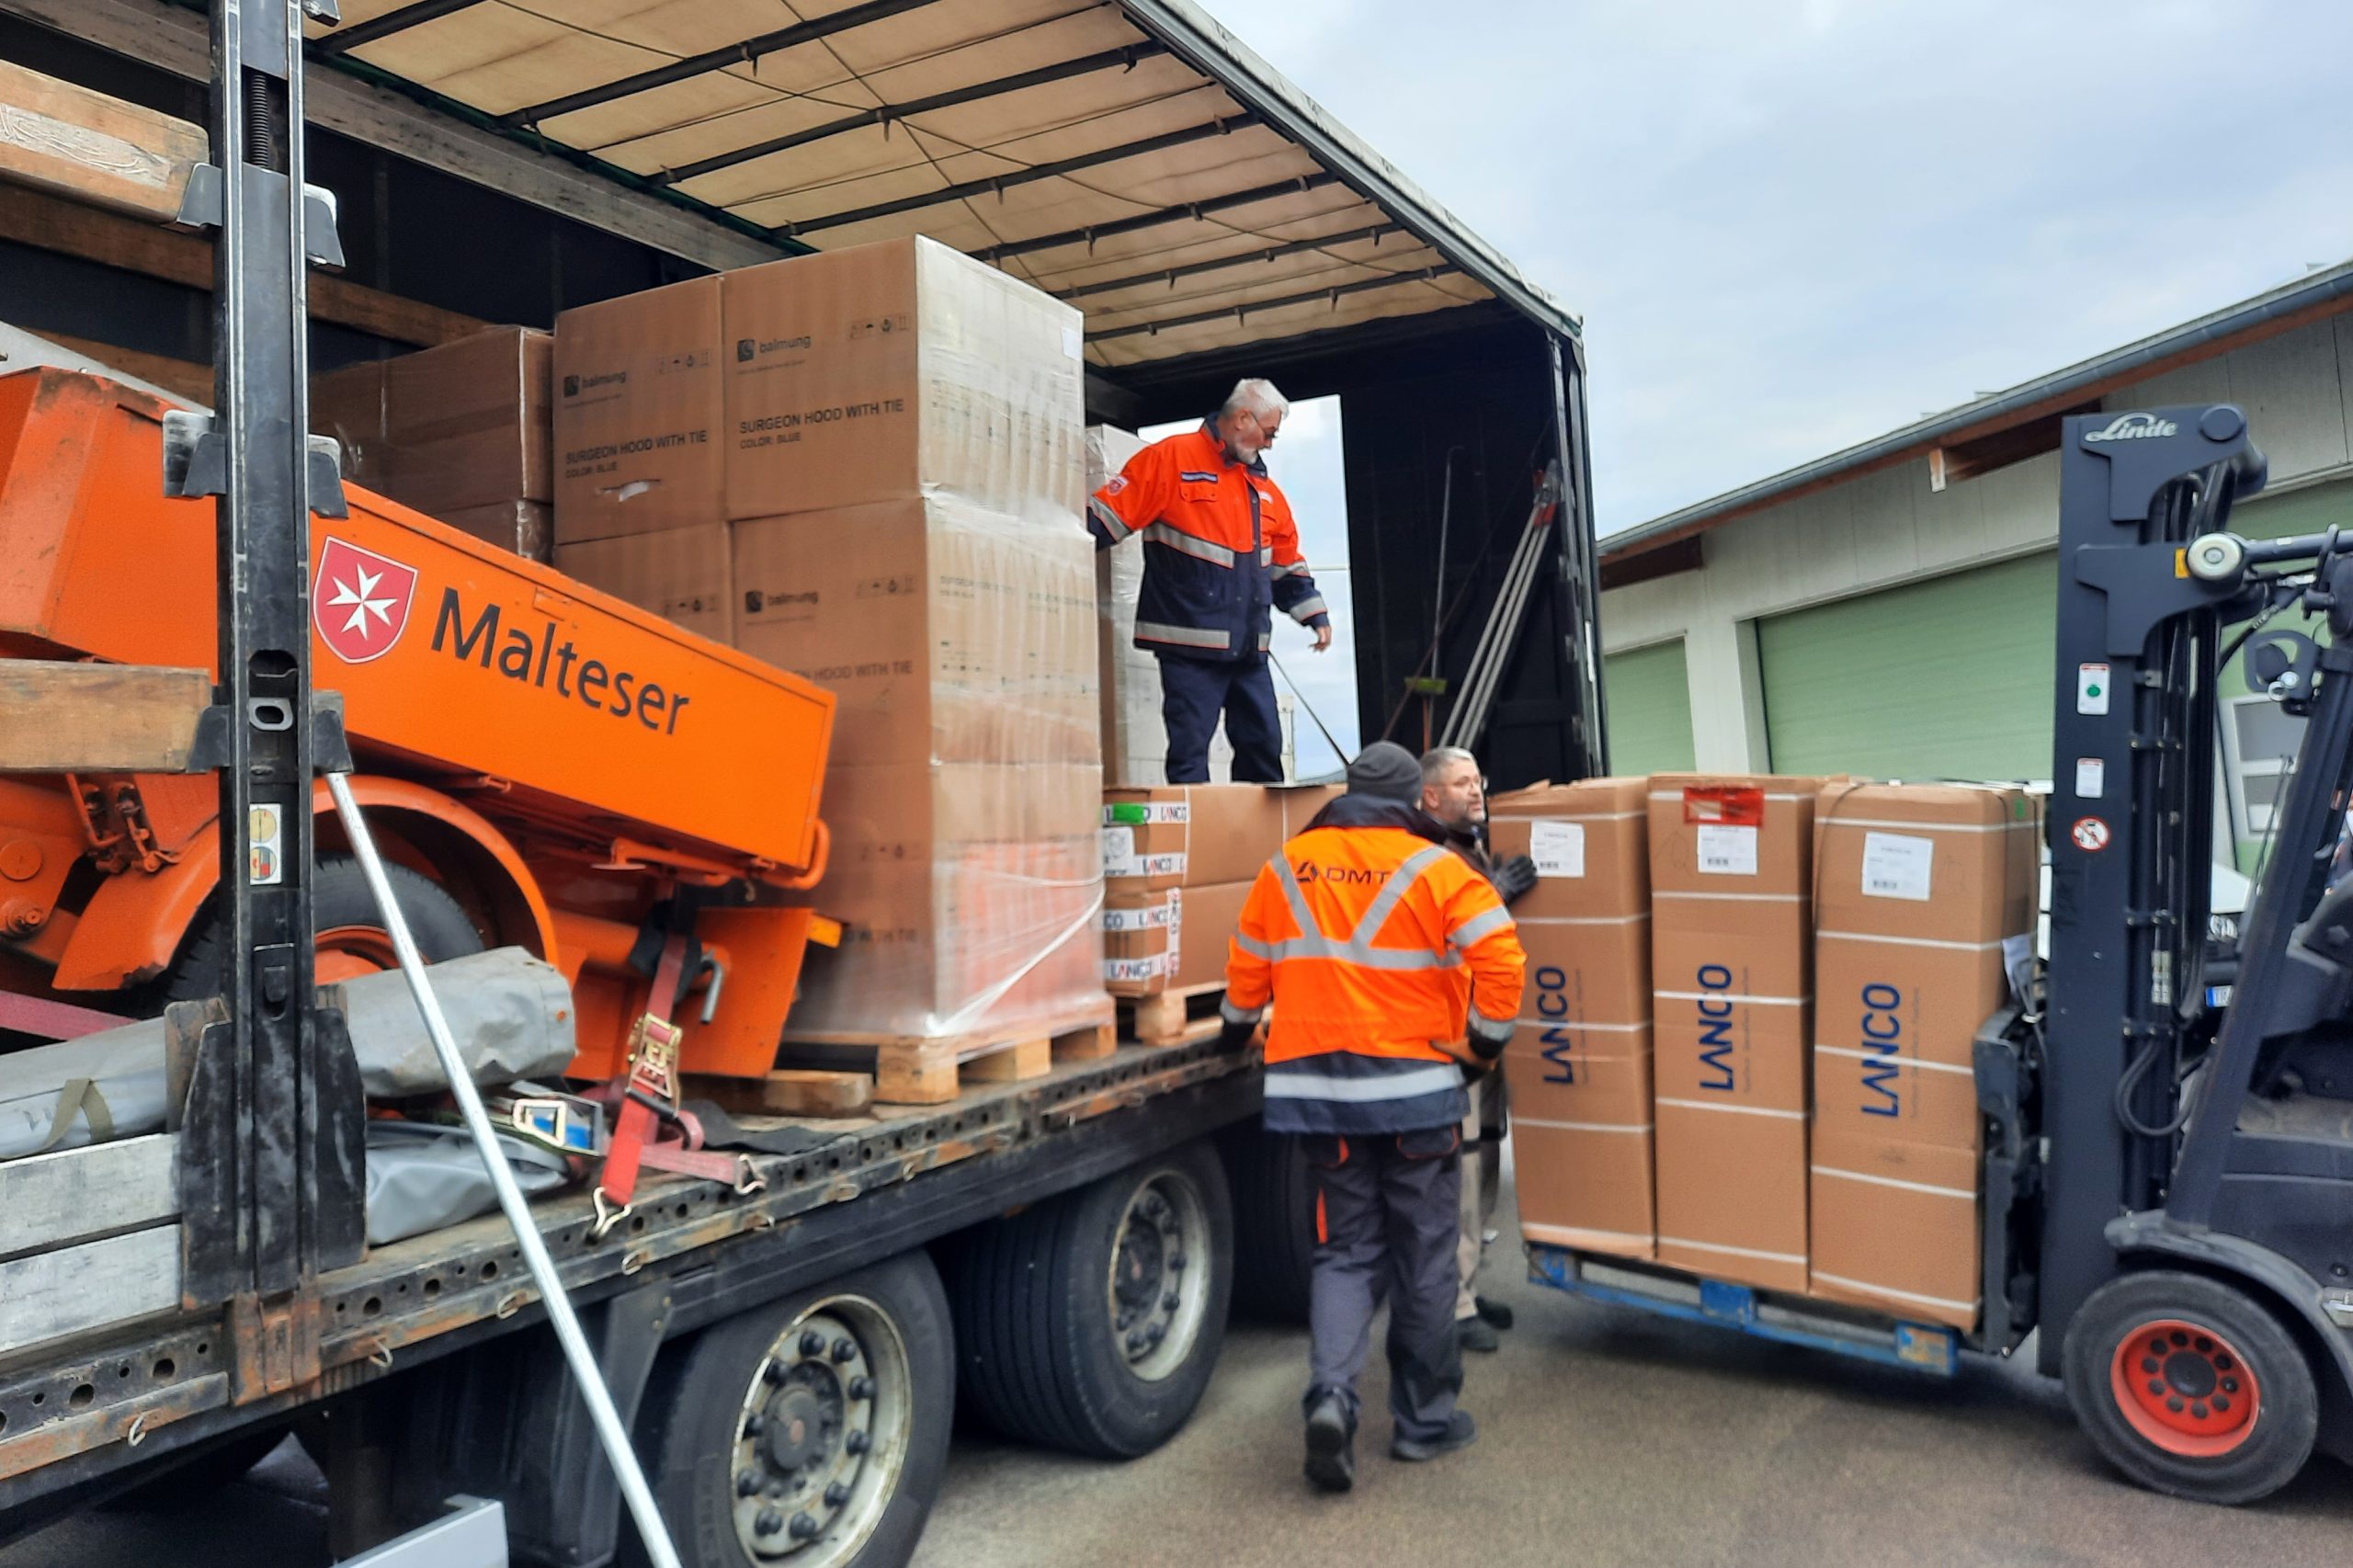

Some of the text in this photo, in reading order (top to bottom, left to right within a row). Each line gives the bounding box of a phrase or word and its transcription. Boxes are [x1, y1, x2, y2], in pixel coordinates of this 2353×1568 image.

[759, 335, 812, 354] balmung
[739, 399, 904, 434] SURGEON HOOD WITH TIE
[2084, 412, 2177, 441] Linde
[565, 430, 707, 464] SURGEON HOOD WITH TIE
[430, 586, 689, 735] Malteser
[1327, 868, 1392, 884] DMT
[1536, 967, 1574, 1084] LANCO
[1697, 965, 1733, 1091] LANCO
[1861, 983, 1900, 1117] LANCO
